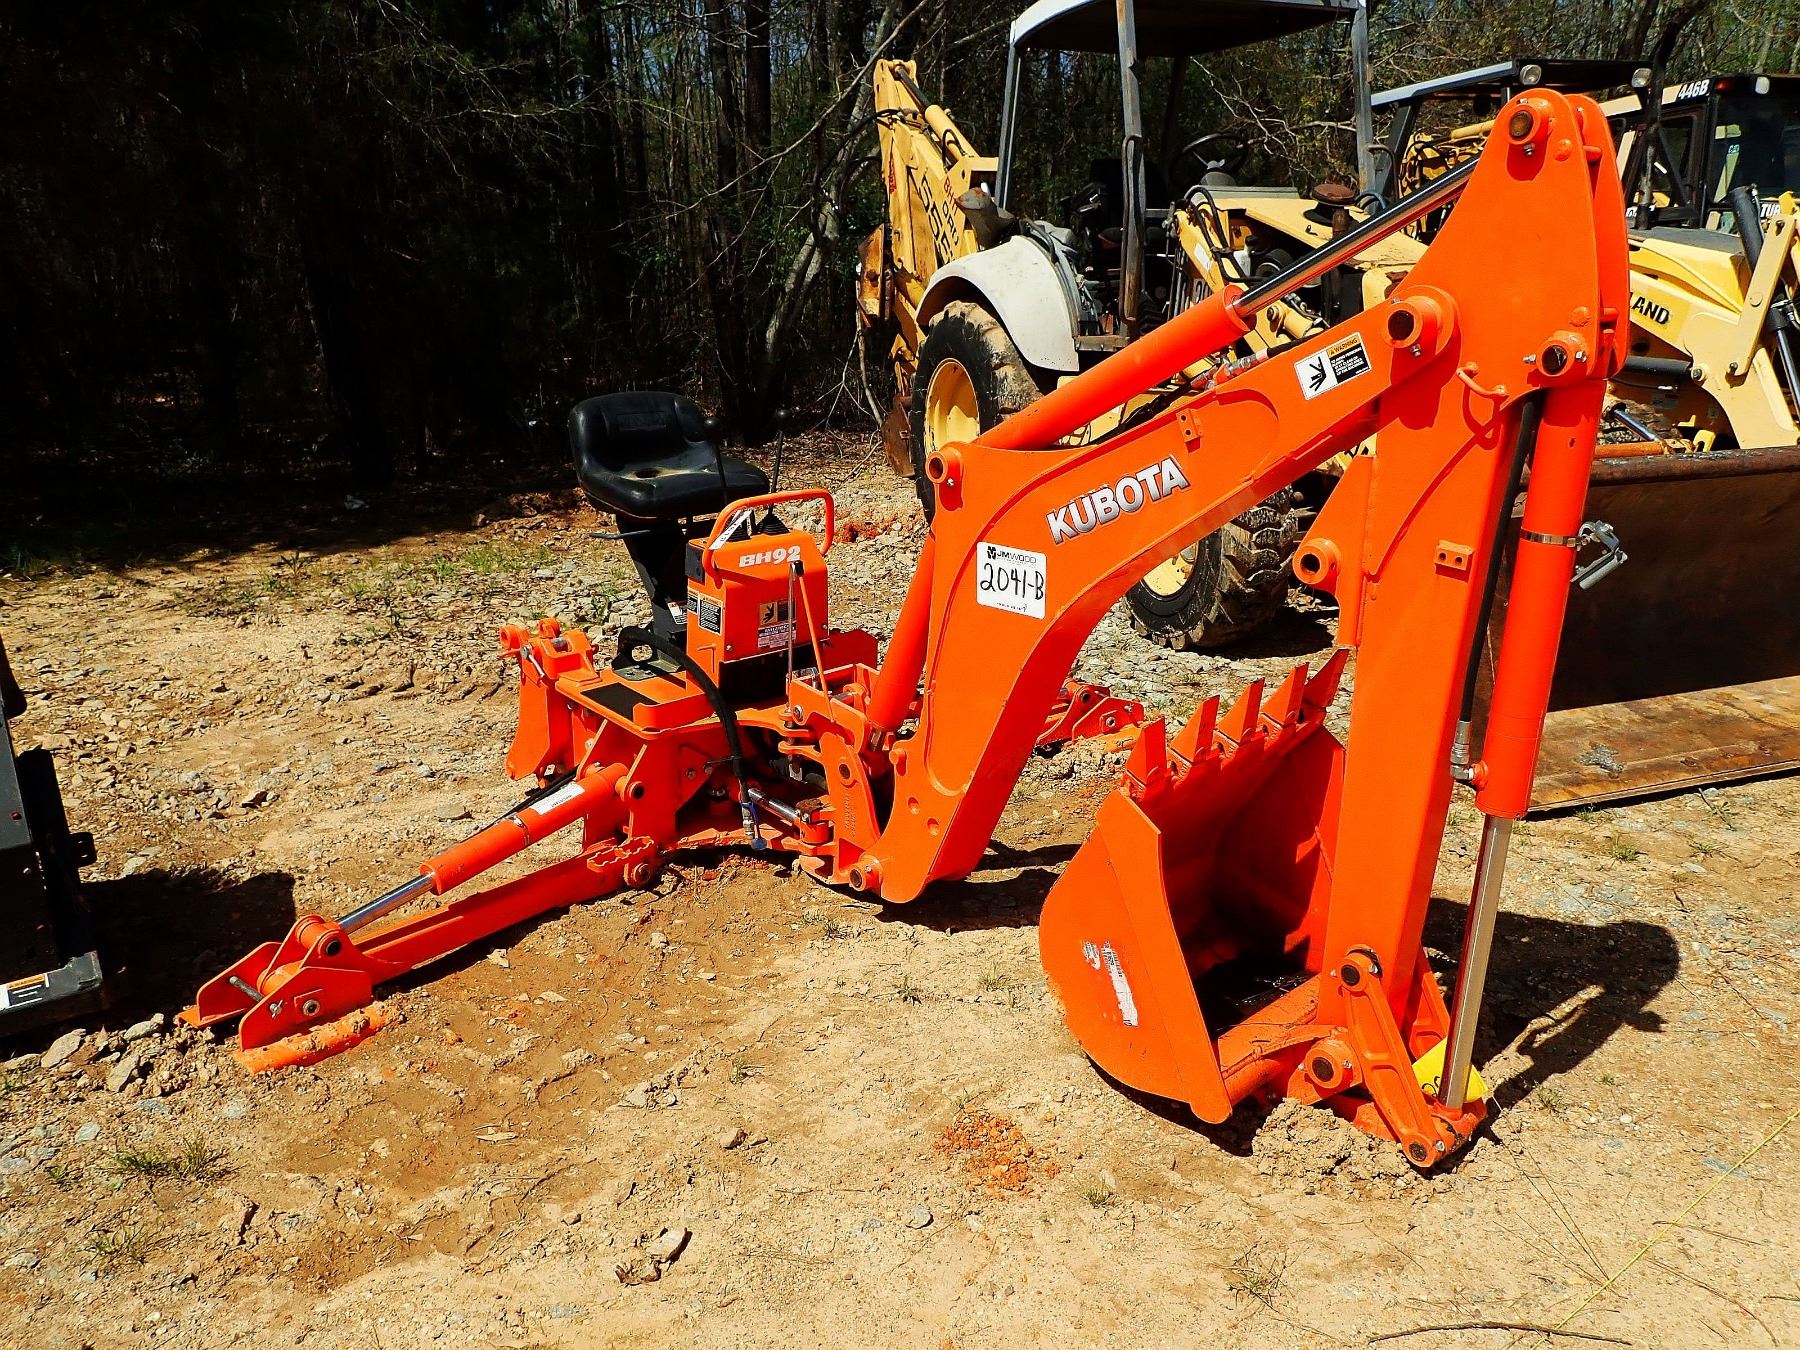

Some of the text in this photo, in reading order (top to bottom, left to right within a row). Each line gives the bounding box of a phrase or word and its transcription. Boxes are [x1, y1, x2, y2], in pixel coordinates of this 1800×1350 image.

[1678, 80, 1710, 99] 446B
[1046, 456, 1190, 545] KUBOTA
[739, 546, 801, 568] BH92
[980, 563, 1044, 600] 2041-B
